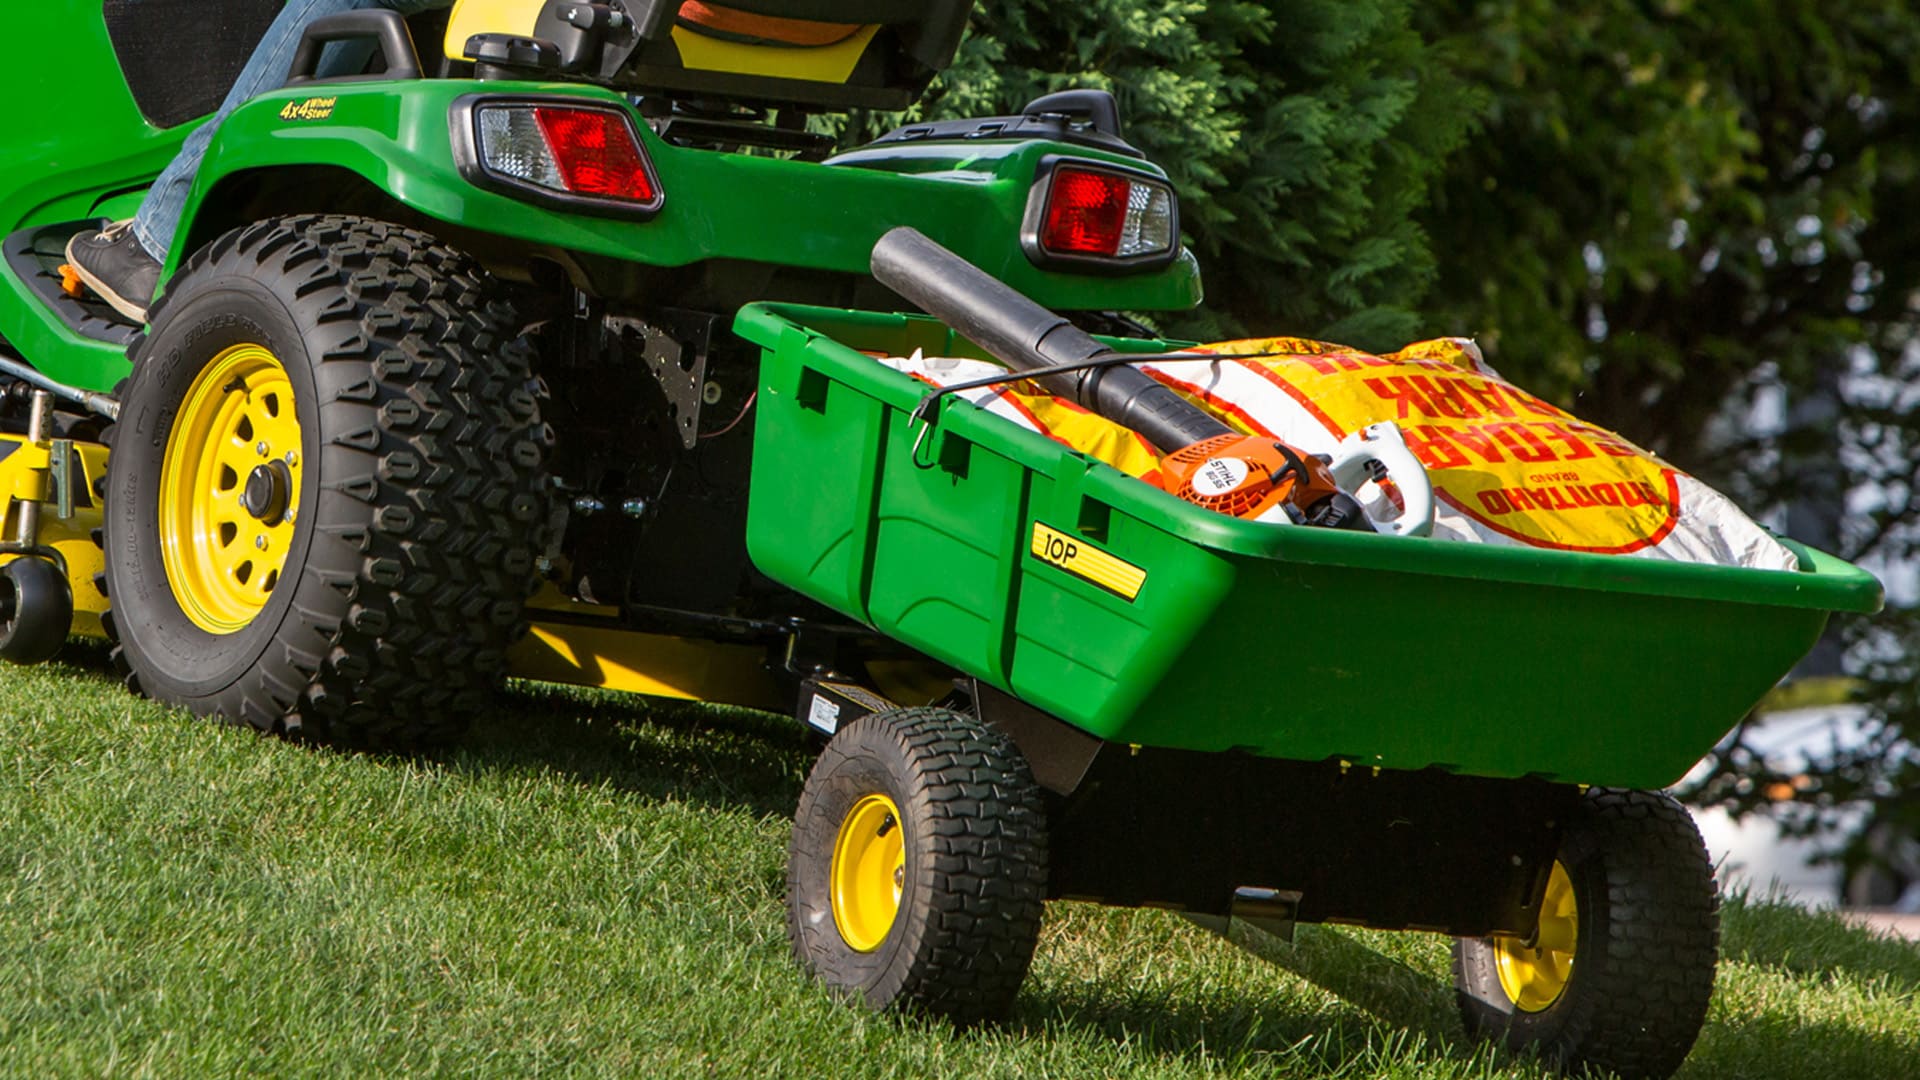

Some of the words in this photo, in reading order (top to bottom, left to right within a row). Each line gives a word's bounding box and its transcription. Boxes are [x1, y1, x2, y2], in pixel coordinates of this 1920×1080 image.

[280, 100, 311, 119] 4x4
[1210, 460, 1236, 486] STIHL
[1529, 471, 1580, 484] BRAND
[1045, 533, 1077, 563] 10P
